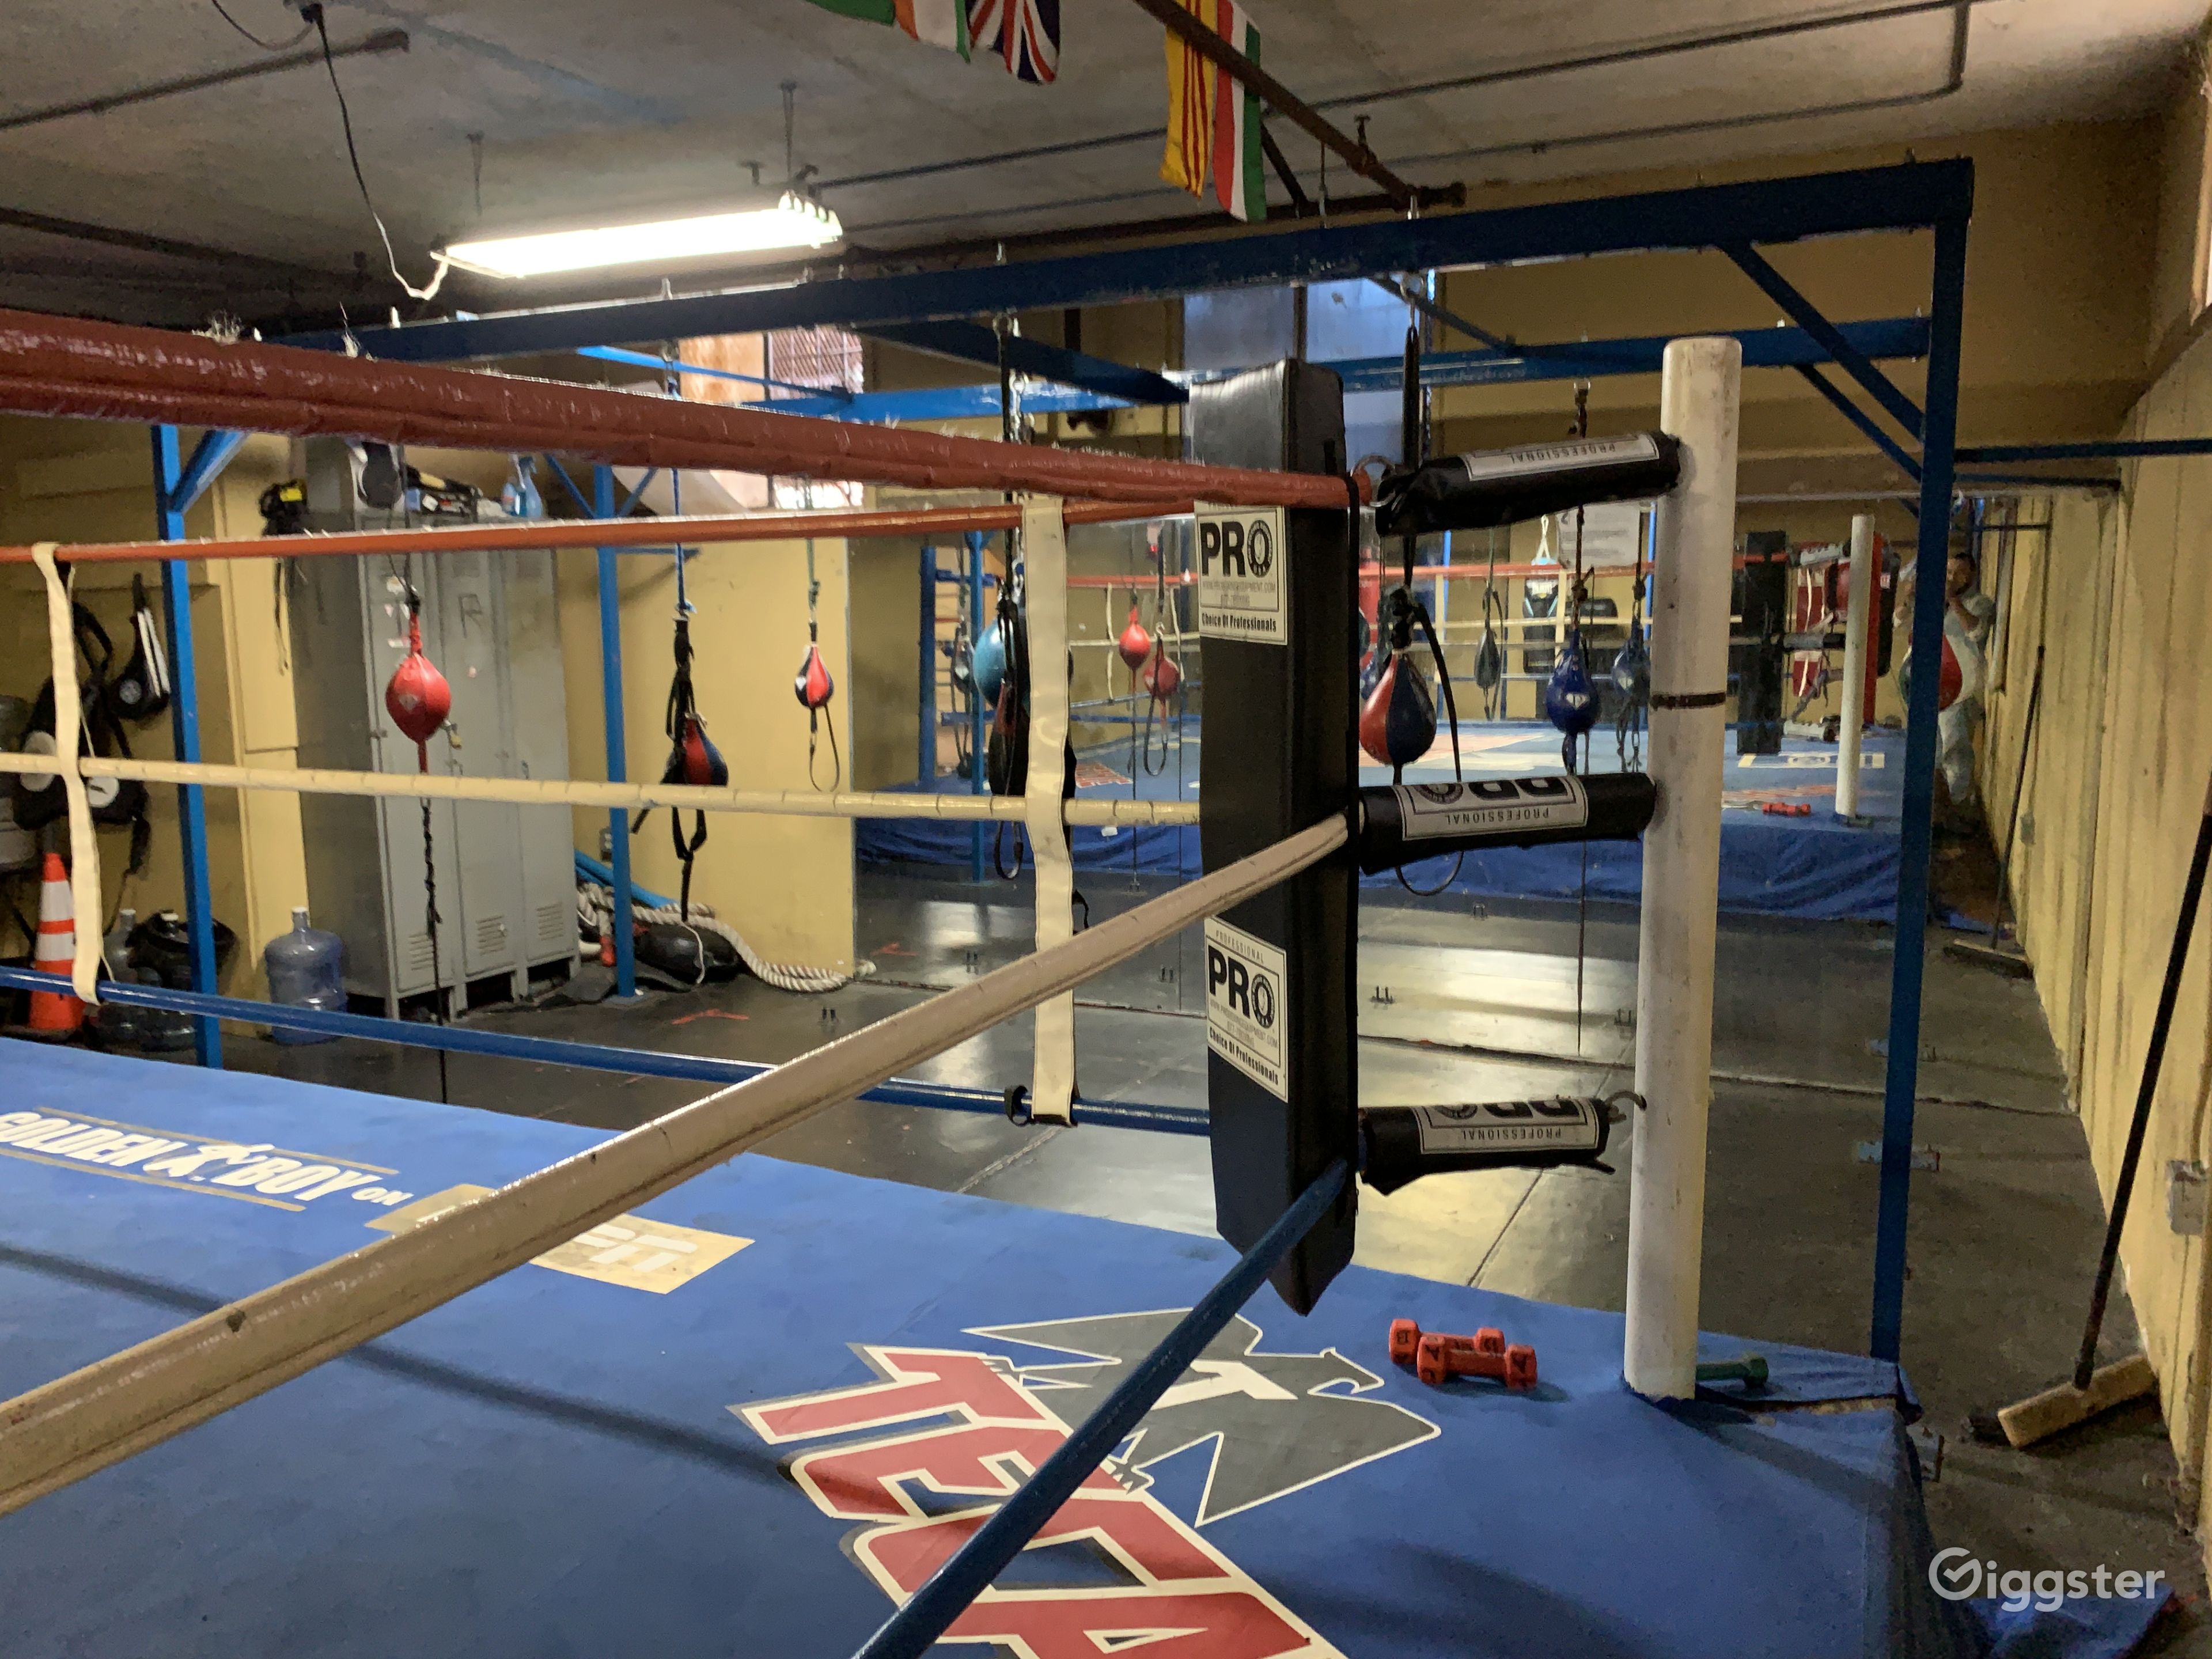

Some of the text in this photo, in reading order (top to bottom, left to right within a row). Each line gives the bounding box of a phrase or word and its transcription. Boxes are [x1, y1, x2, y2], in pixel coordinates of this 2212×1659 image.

[1510, 442, 1615, 464] PROFESSIONAL
[1200, 520, 1273, 577] PRO
[1202, 613, 1221, 627] Choice
[1230, 615, 1277, 632] Professionals
[1445, 807, 1550, 825] PROFESSIONAL
[1215, 929, 1264, 965] PROFESSIONAL
[1209, 945, 1275, 1029] PRO
[1210, 1027, 1228, 1050] Choice
[1236, 1046, 1279, 1086] Professionals
[1462, 1127, 1562, 1141] PROFESSIONAL
[210, 1154, 382, 1202] BOY
